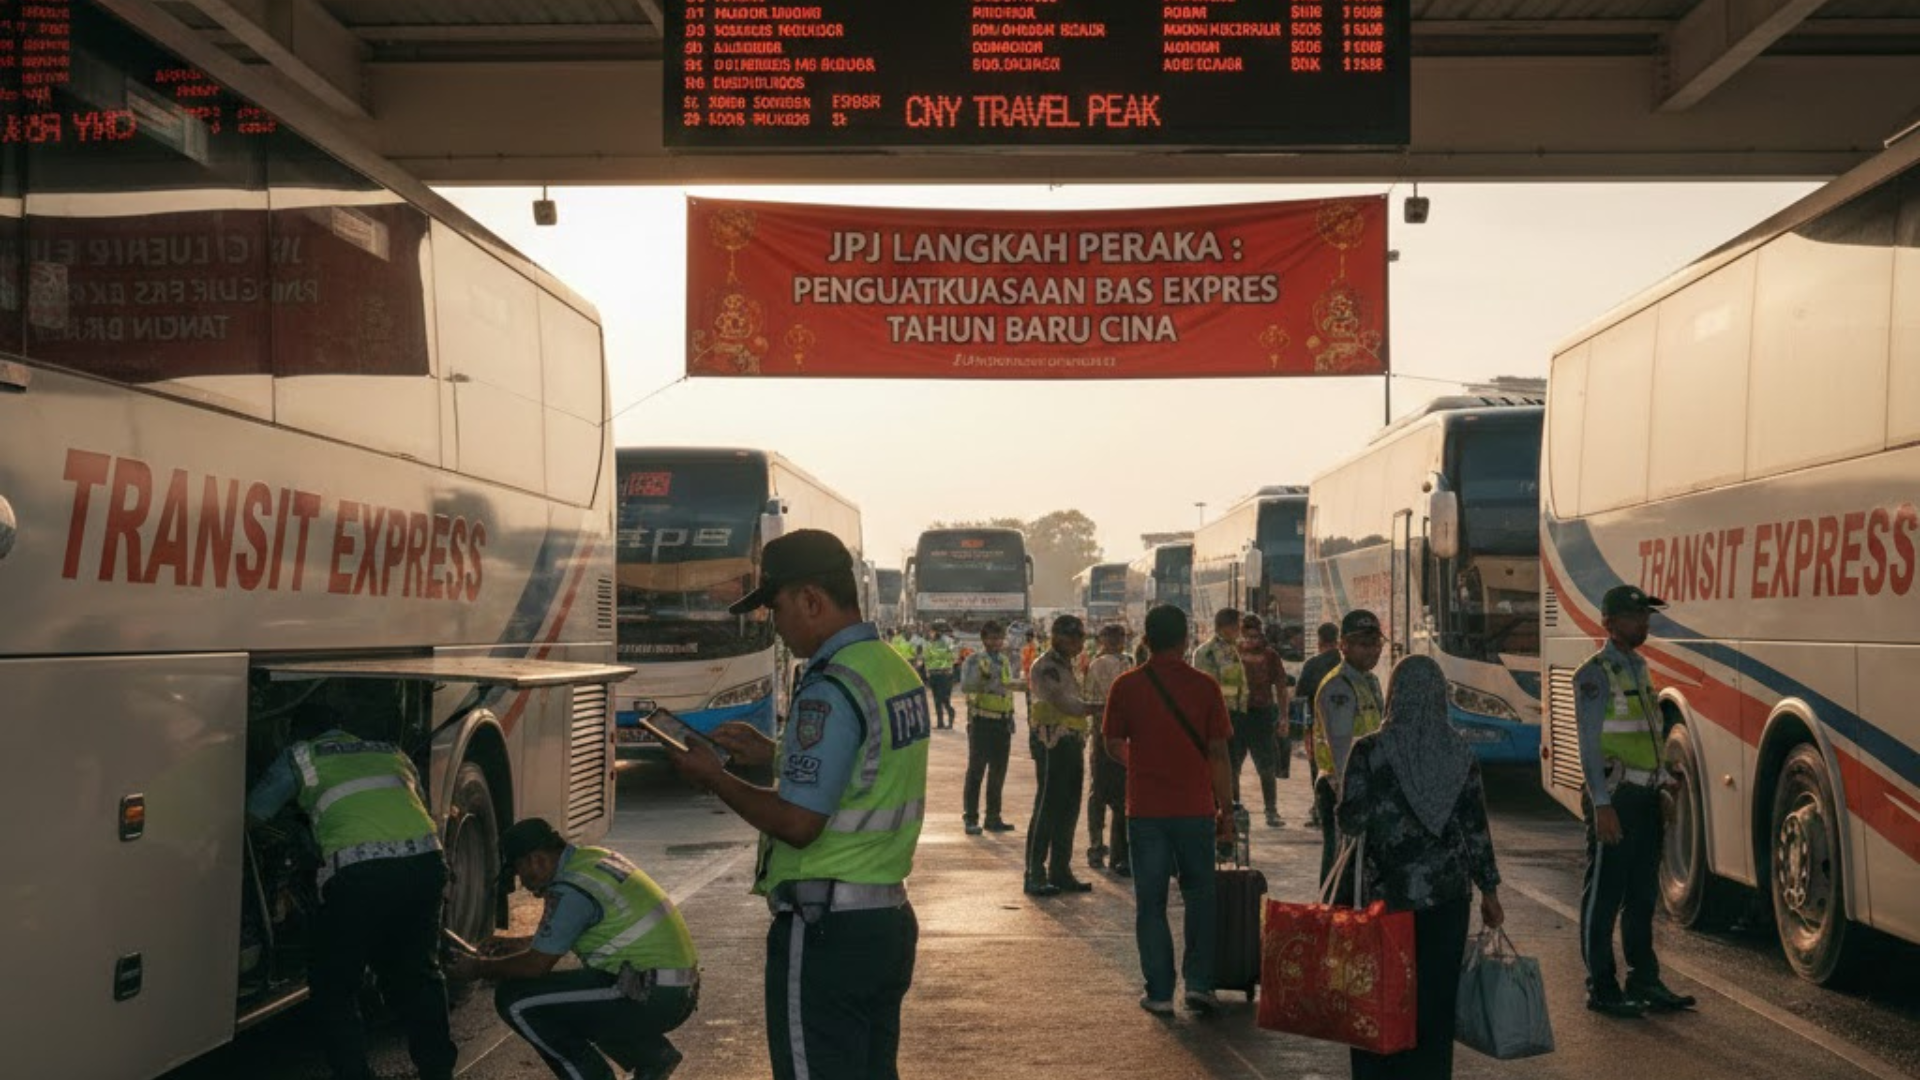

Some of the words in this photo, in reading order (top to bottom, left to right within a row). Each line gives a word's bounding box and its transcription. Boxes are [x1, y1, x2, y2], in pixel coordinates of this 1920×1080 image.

[905, 94, 963, 128] CNY
[972, 94, 1081, 128] TRAVEL
[1087, 93, 1161, 128] PEAK
[827, 231, 880, 263] JPJ
[893, 232, 1068, 263] LANGKAH
[1078, 231, 1222, 263] PERAKA
[793, 275, 1085, 305] PENGUATKUASAAN
[1095, 276, 1154, 305] BAS
[1163, 274, 1277, 304] EKPRES
[886, 315, 996, 343] TAHUN
[1005, 315, 1091, 344] BARU
[1099, 315, 1178, 343] CINA
[62, 448, 321, 591] TRANSIT
[327, 499, 487, 601] EXPRESS
[1638, 527, 1746, 603] TRANSIT
[1751, 502, 1919, 600] EXPRESS
